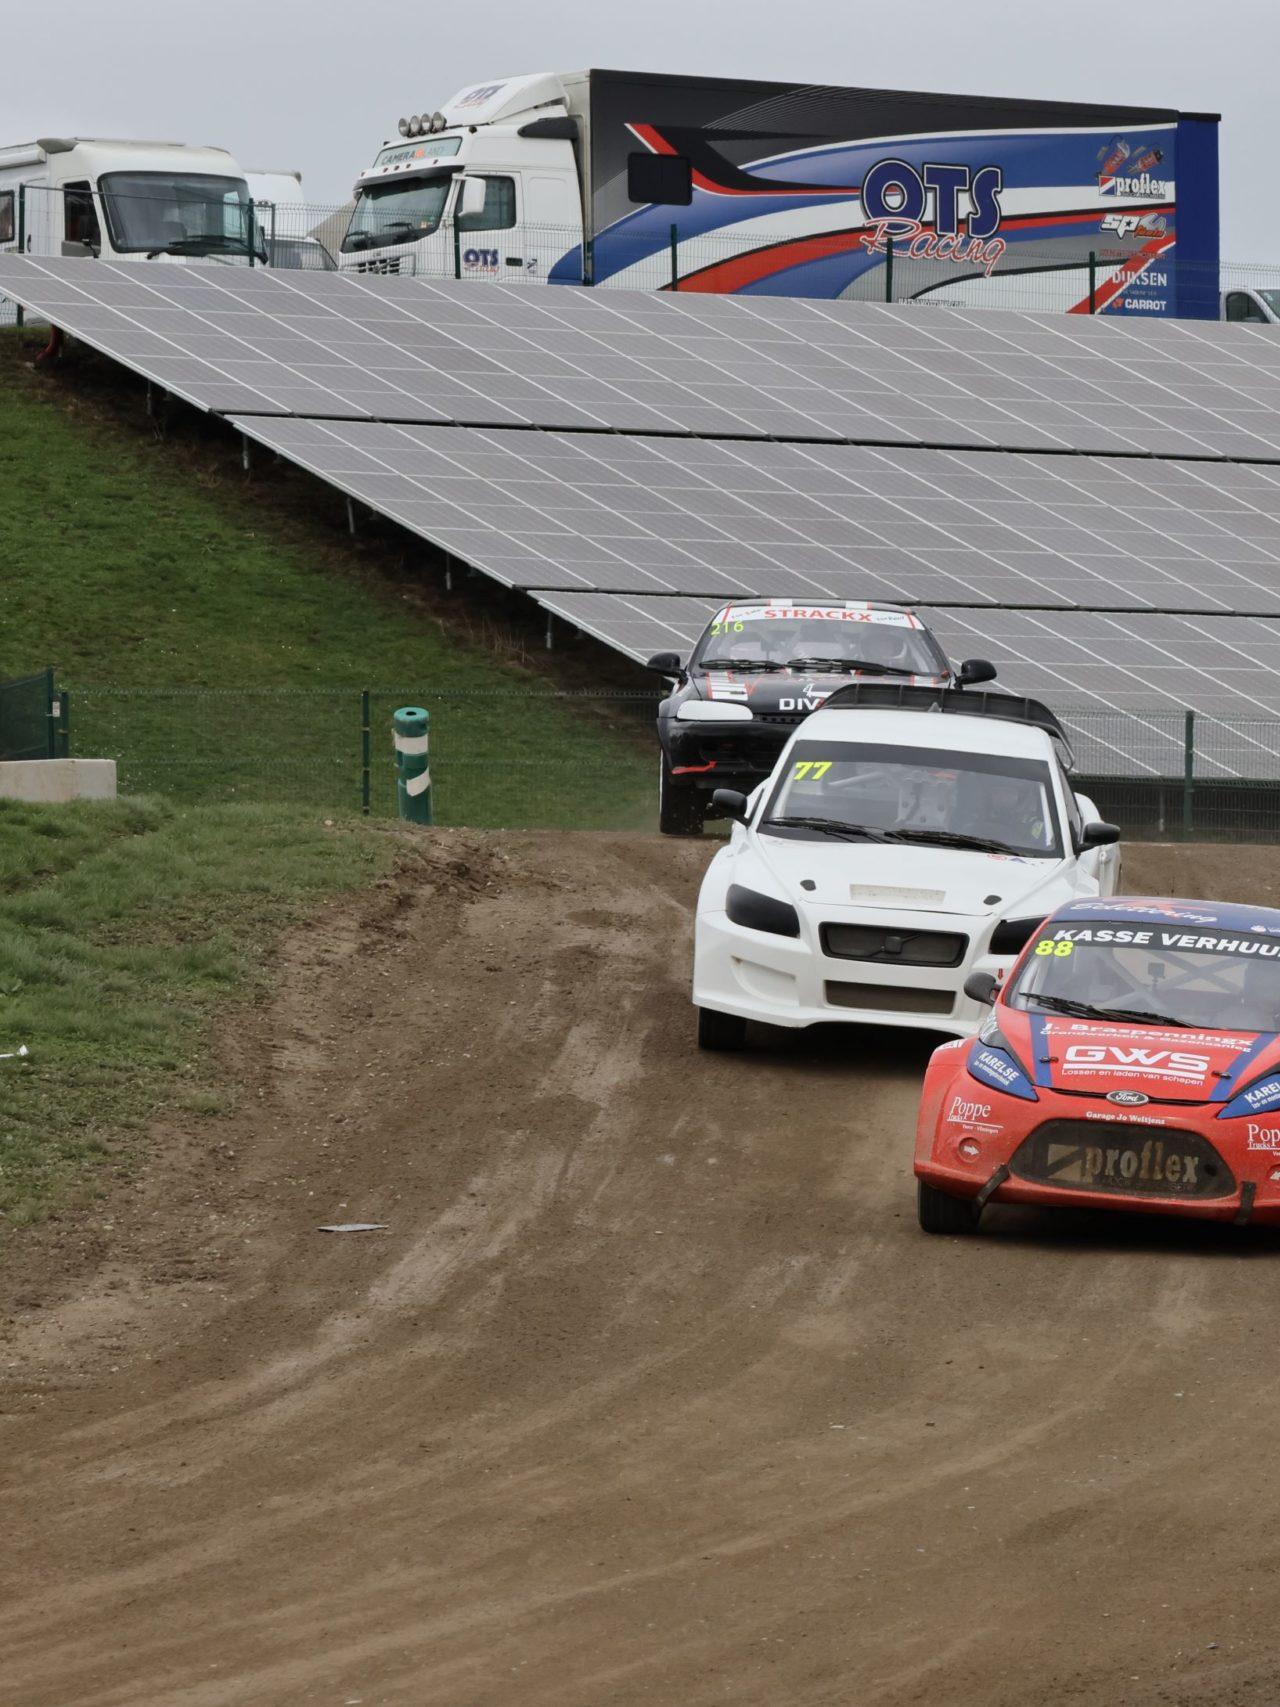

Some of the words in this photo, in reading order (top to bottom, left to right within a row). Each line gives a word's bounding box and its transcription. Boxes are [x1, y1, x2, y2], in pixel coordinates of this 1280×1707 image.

[1116, 172, 1166, 196] proflex
[861, 157, 1004, 240] OTS
[859, 217, 1006, 278] Racing
[463, 248, 499, 267] OTS
[1124, 298, 1168, 312] CARROT
[764, 609, 873, 622] STRACKX
[711, 620, 745, 636] 216
[792, 761, 833, 781] 77
[1052, 929, 1154, 945] KASSE
[1034, 940, 1075, 957] 88
[978, 1051, 1020, 1082] KARELSE
[1065, 1045, 1211, 1072] GWS
[1061, 1068, 1097, 1076] Lossen
[1113, 1070, 1140, 1078] laden
[1162, 1074, 1205, 1087] schepen
[1114, 1091, 1140, 1103] Ford
[950, 1095, 992, 1121] Poppe
[1085, 1110, 1116, 1121] Garage
[1082, 1139, 1200, 1185] proflex
